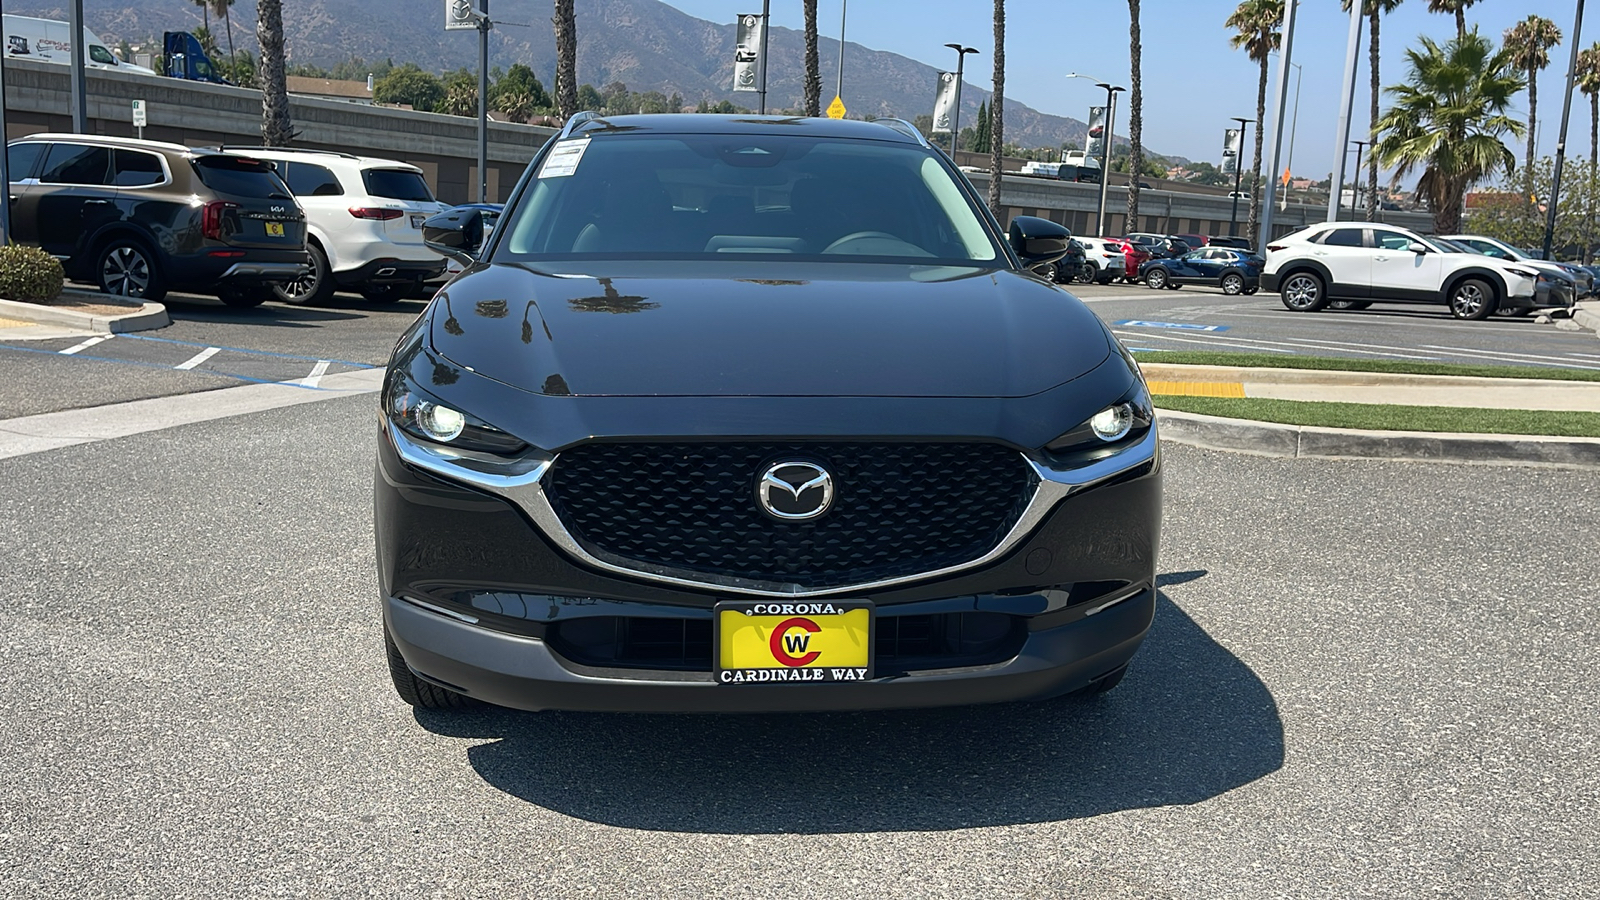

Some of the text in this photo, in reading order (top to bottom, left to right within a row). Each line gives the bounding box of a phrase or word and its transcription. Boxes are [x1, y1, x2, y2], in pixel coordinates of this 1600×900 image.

[39, 39, 70, 47] FORKLIF
[753, 603, 837, 615] CORONA
[769, 617, 822, 667] C
[784, 633, 812, 653] W
[720, 668, 868, 682] CARDINALE WAY
